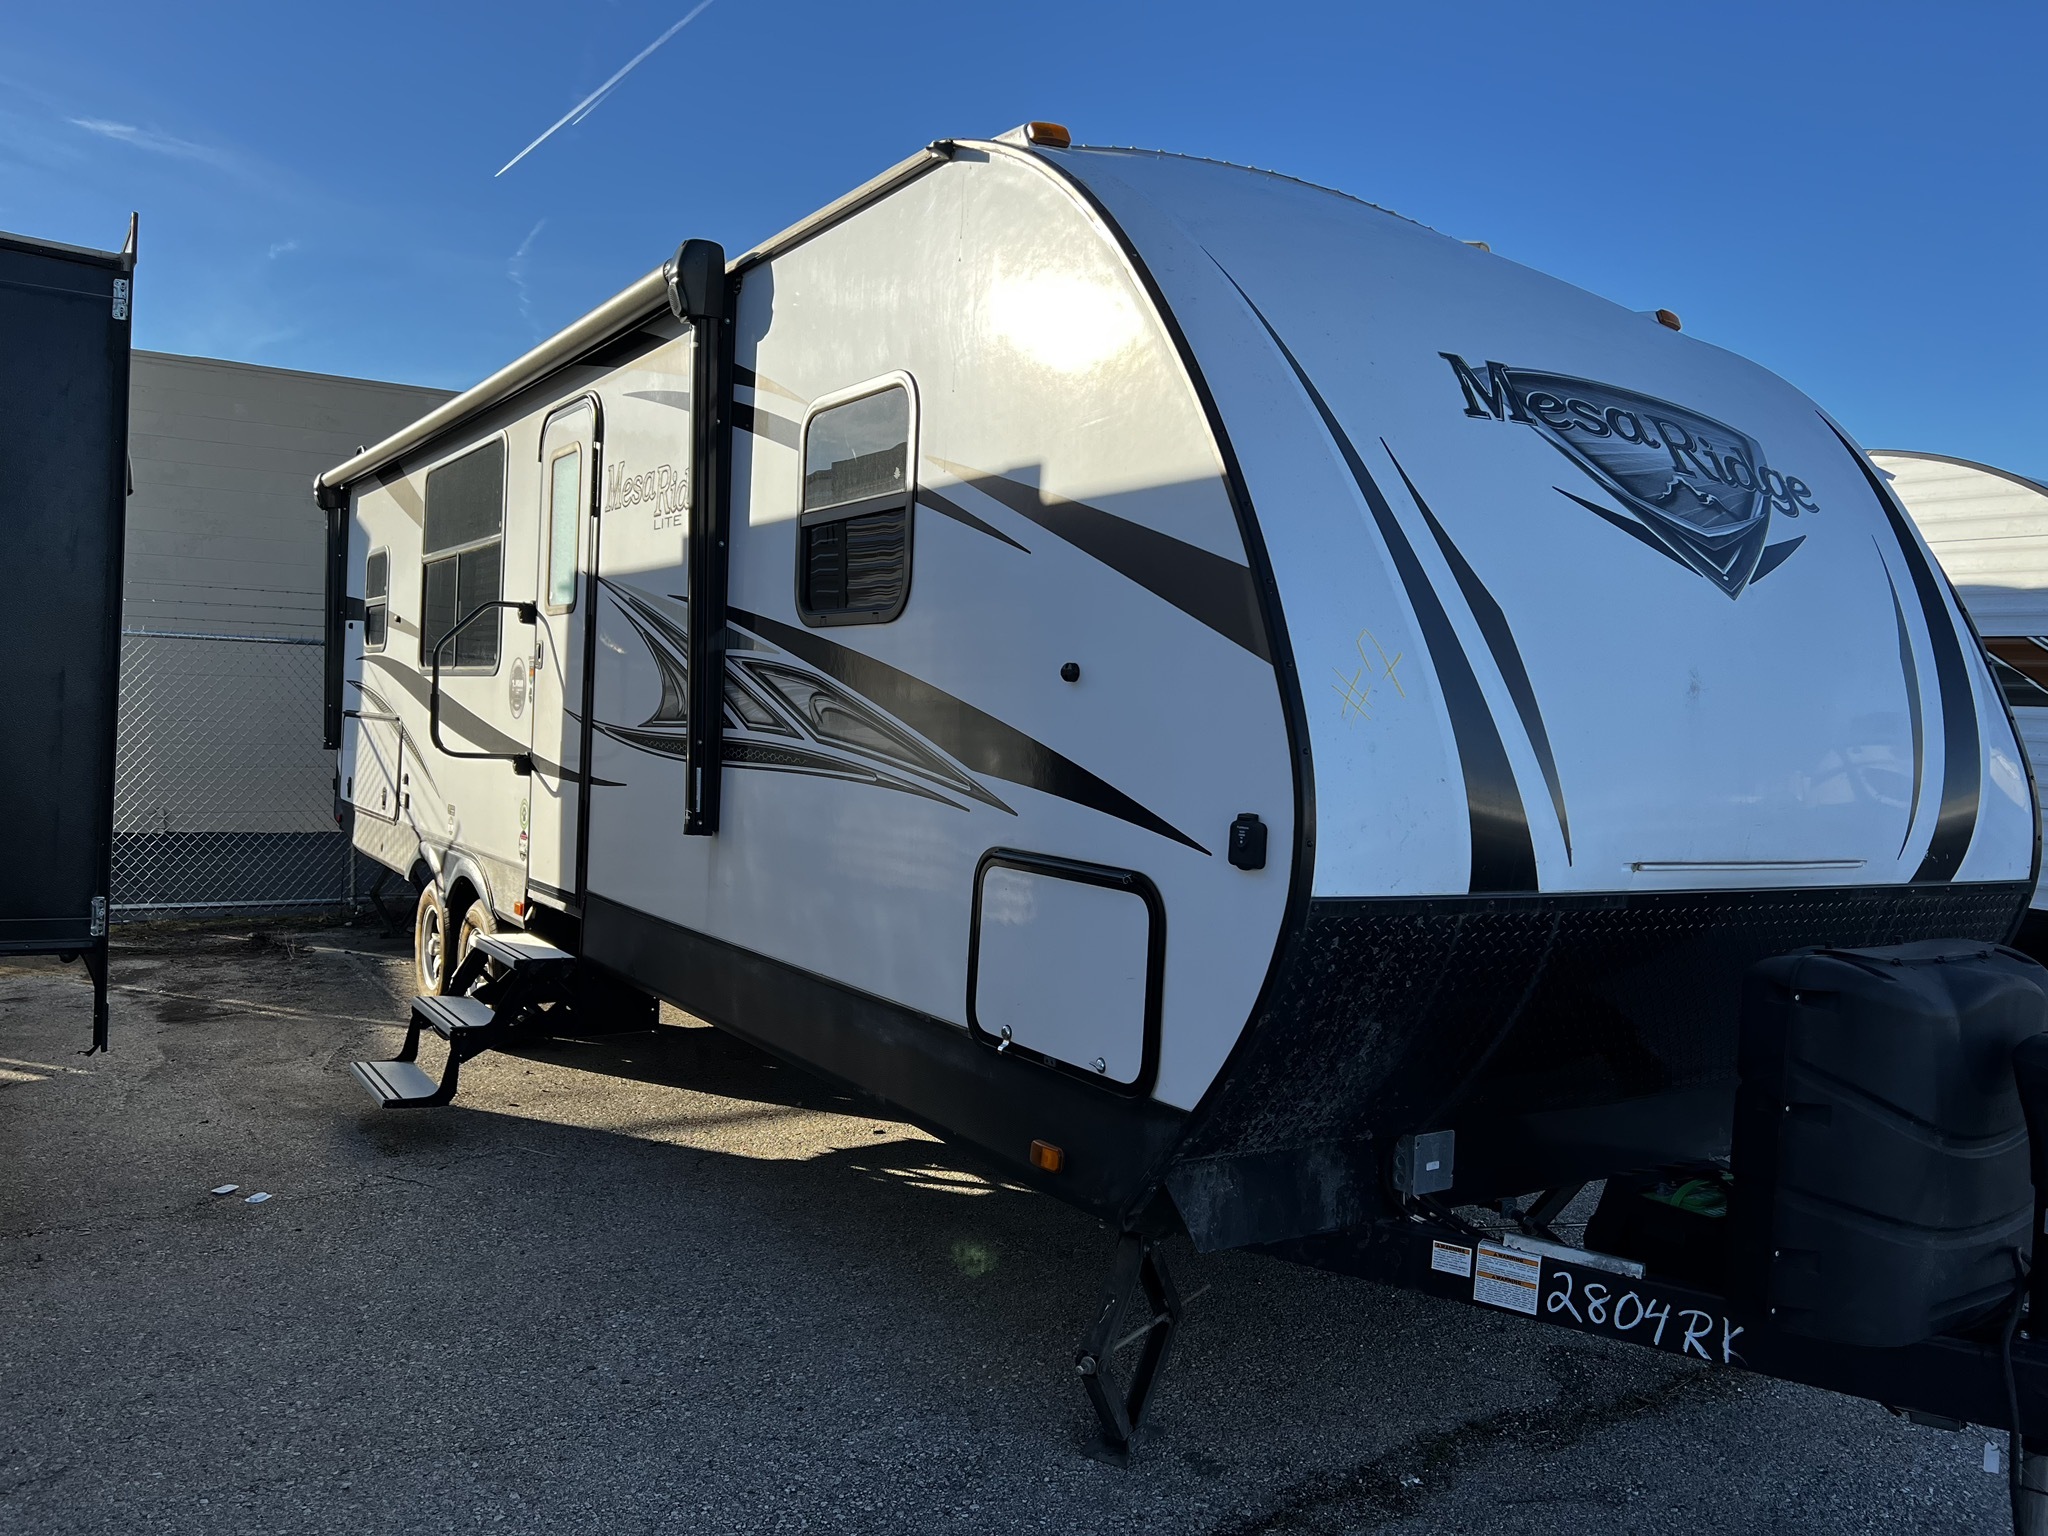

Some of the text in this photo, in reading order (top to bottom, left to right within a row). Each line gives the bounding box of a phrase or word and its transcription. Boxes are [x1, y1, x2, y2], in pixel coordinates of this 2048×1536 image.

[1437, 351, 1820, 518] Mesa Ridge
[604, 461, 691, 517] Mesa Rid
[653, 514, 682, 530] LITE
[1498, 1252, 1524, 1263] WARNING
[1496, 1275, 1522, 1286] WARNING
